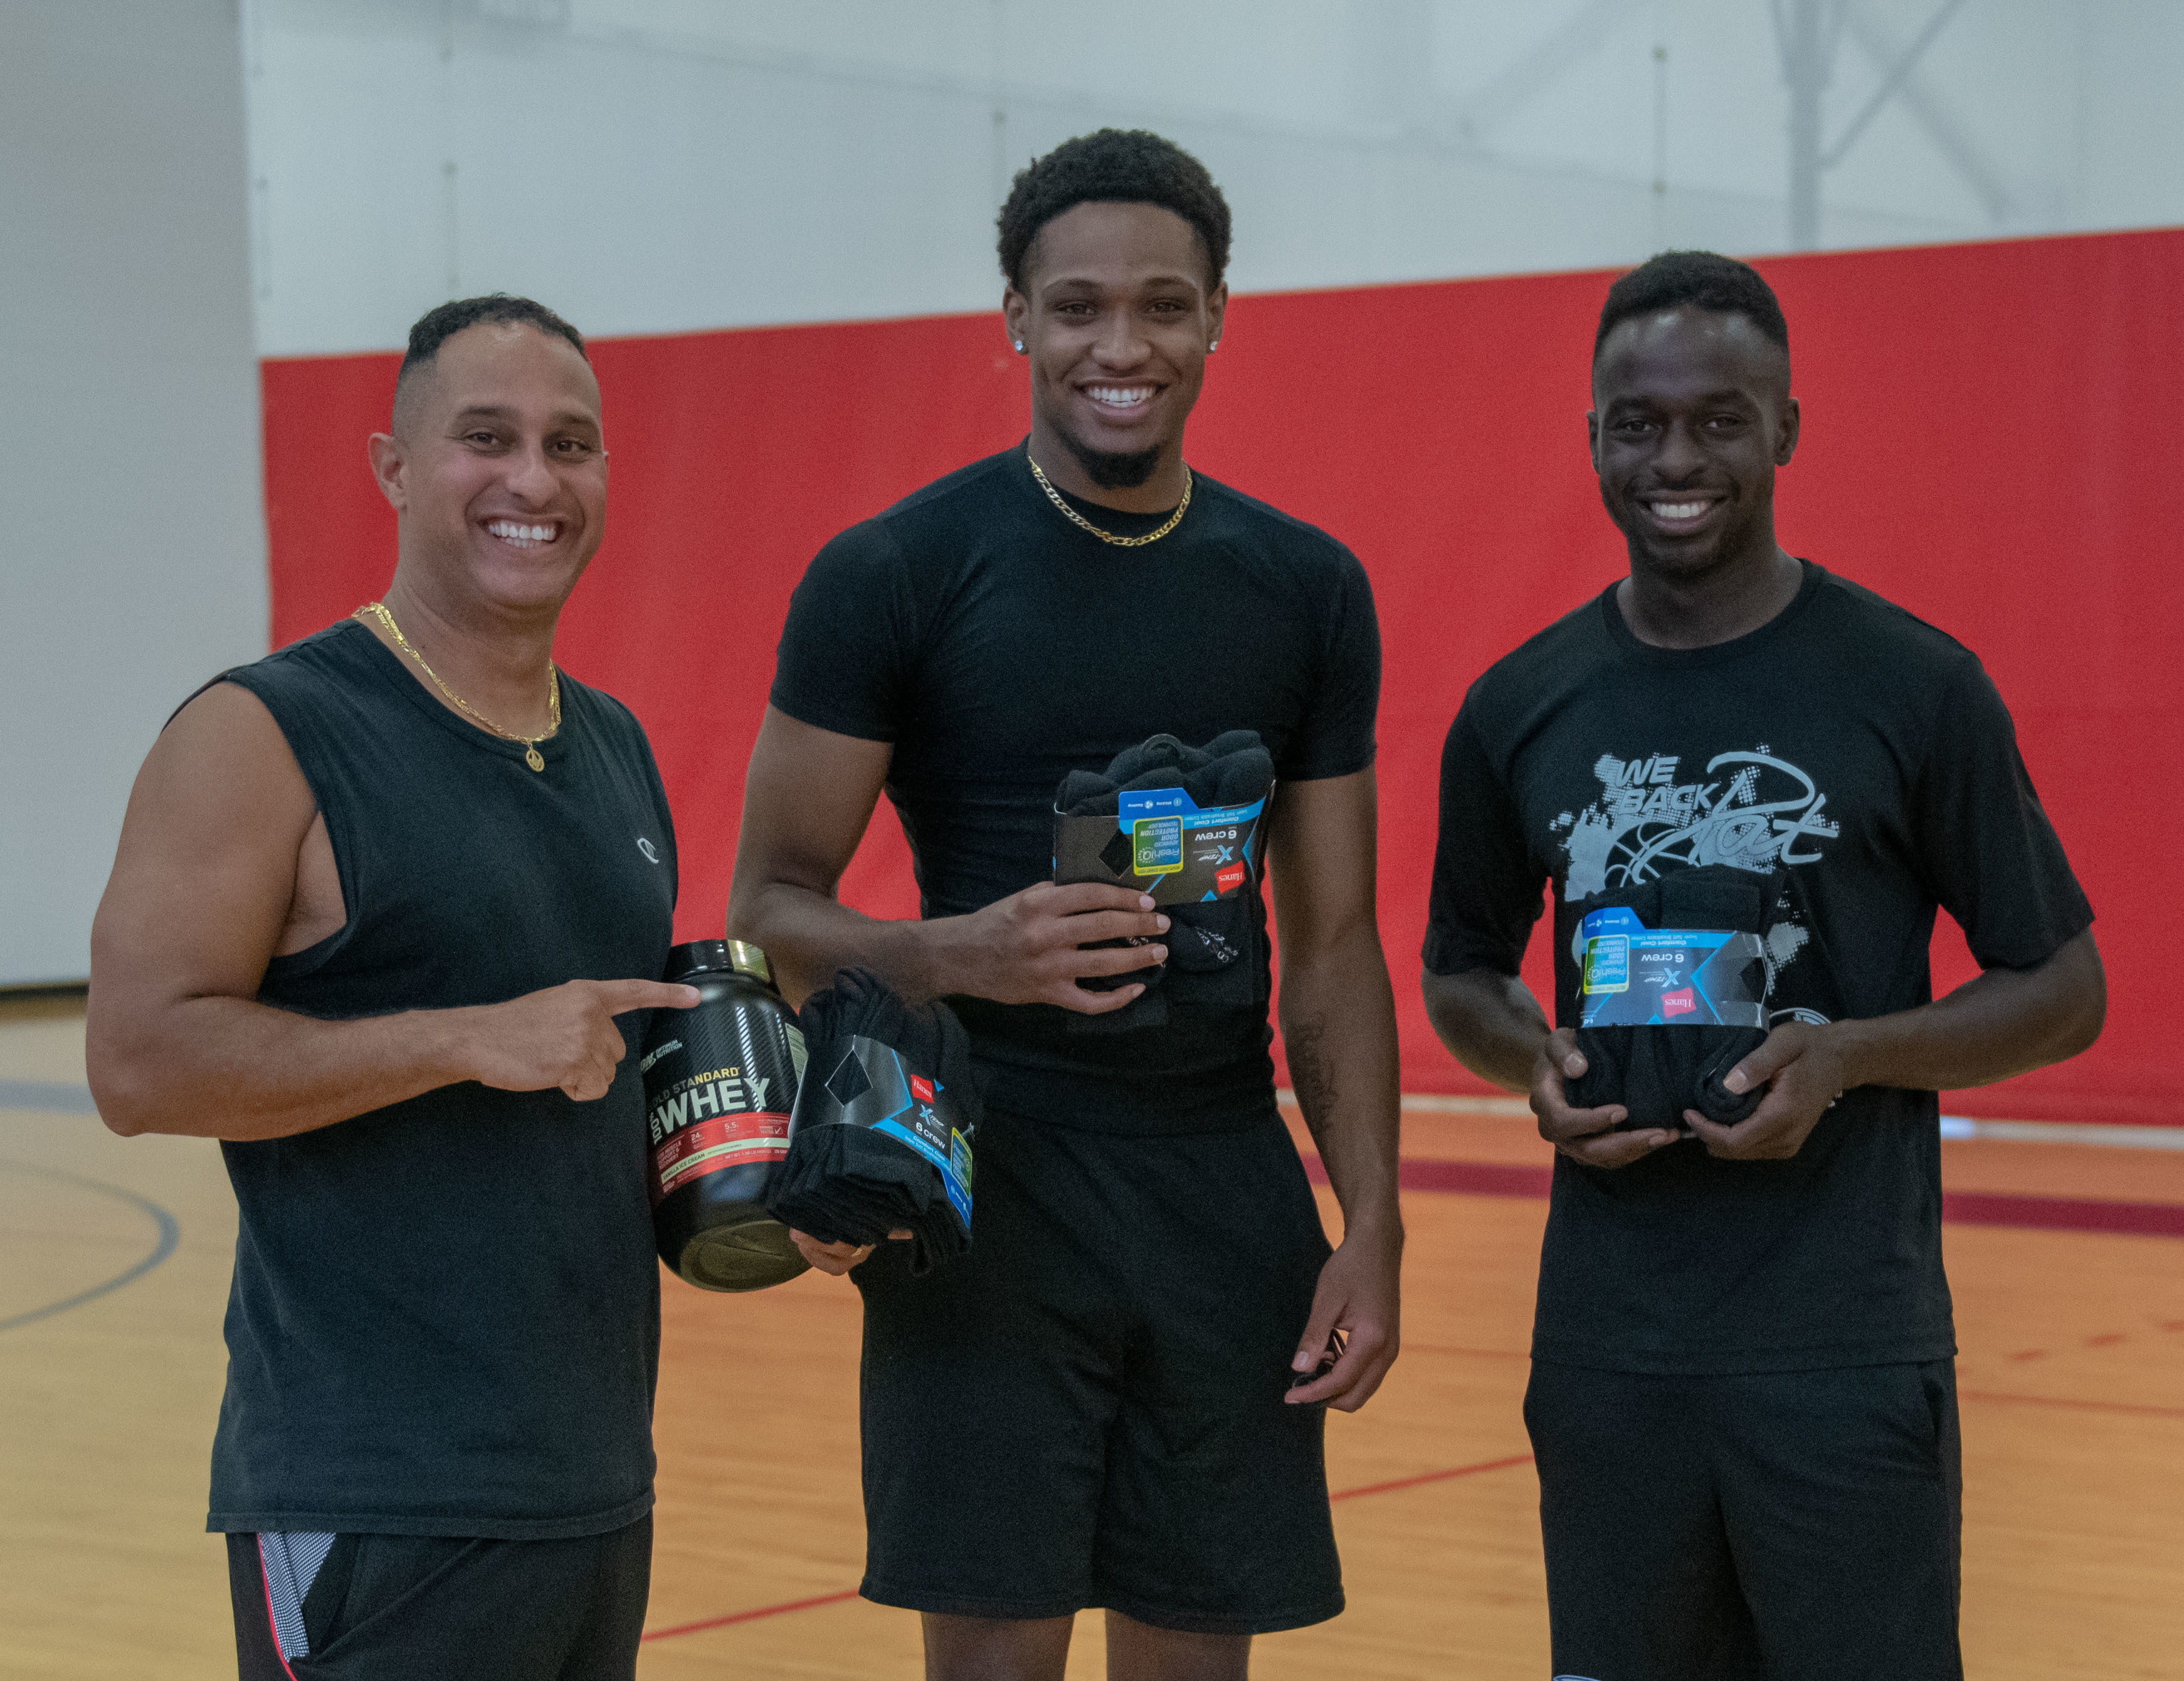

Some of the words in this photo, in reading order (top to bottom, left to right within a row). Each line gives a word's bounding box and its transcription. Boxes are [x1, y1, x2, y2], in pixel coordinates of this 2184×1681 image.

[1615, 756, 1680, 786] WE
[1618, 783, 1721, 814] BACK
[1147, 821, 1178, 829] TECHNOLOGY
[1212, 816, 1239, 825] Comfort
[1140, 827, 1178, 836] PROTECTION
[1195, 831, 1226, 841] crew
[1228, 829, 1237, 840] 6
[1219, 872, 1242, 882] Hanes
[1675, 953, 1684, 962] 6
[1665, 999, 1692, 1008] Hanes
[655, 1040, 678, 1054] OPTIMUM
[657, 1042, 682, 1059] NUTRITION
[913, 1078, 932, 1099] Hanes
[651, 1090, 670, 1107] OLD
[657, 1077, 770, 1134] WHEY
[649, 1111, 662, 1145] 100%
[915, 1122, 923, 1132] 6
[924, 1128, 946, 1150] crew
[913, 1135, 934, 1153] Comfort
[662, 1166, 679, 1180] VANILLA
[688, 1153, 705, 1164] CREAM
